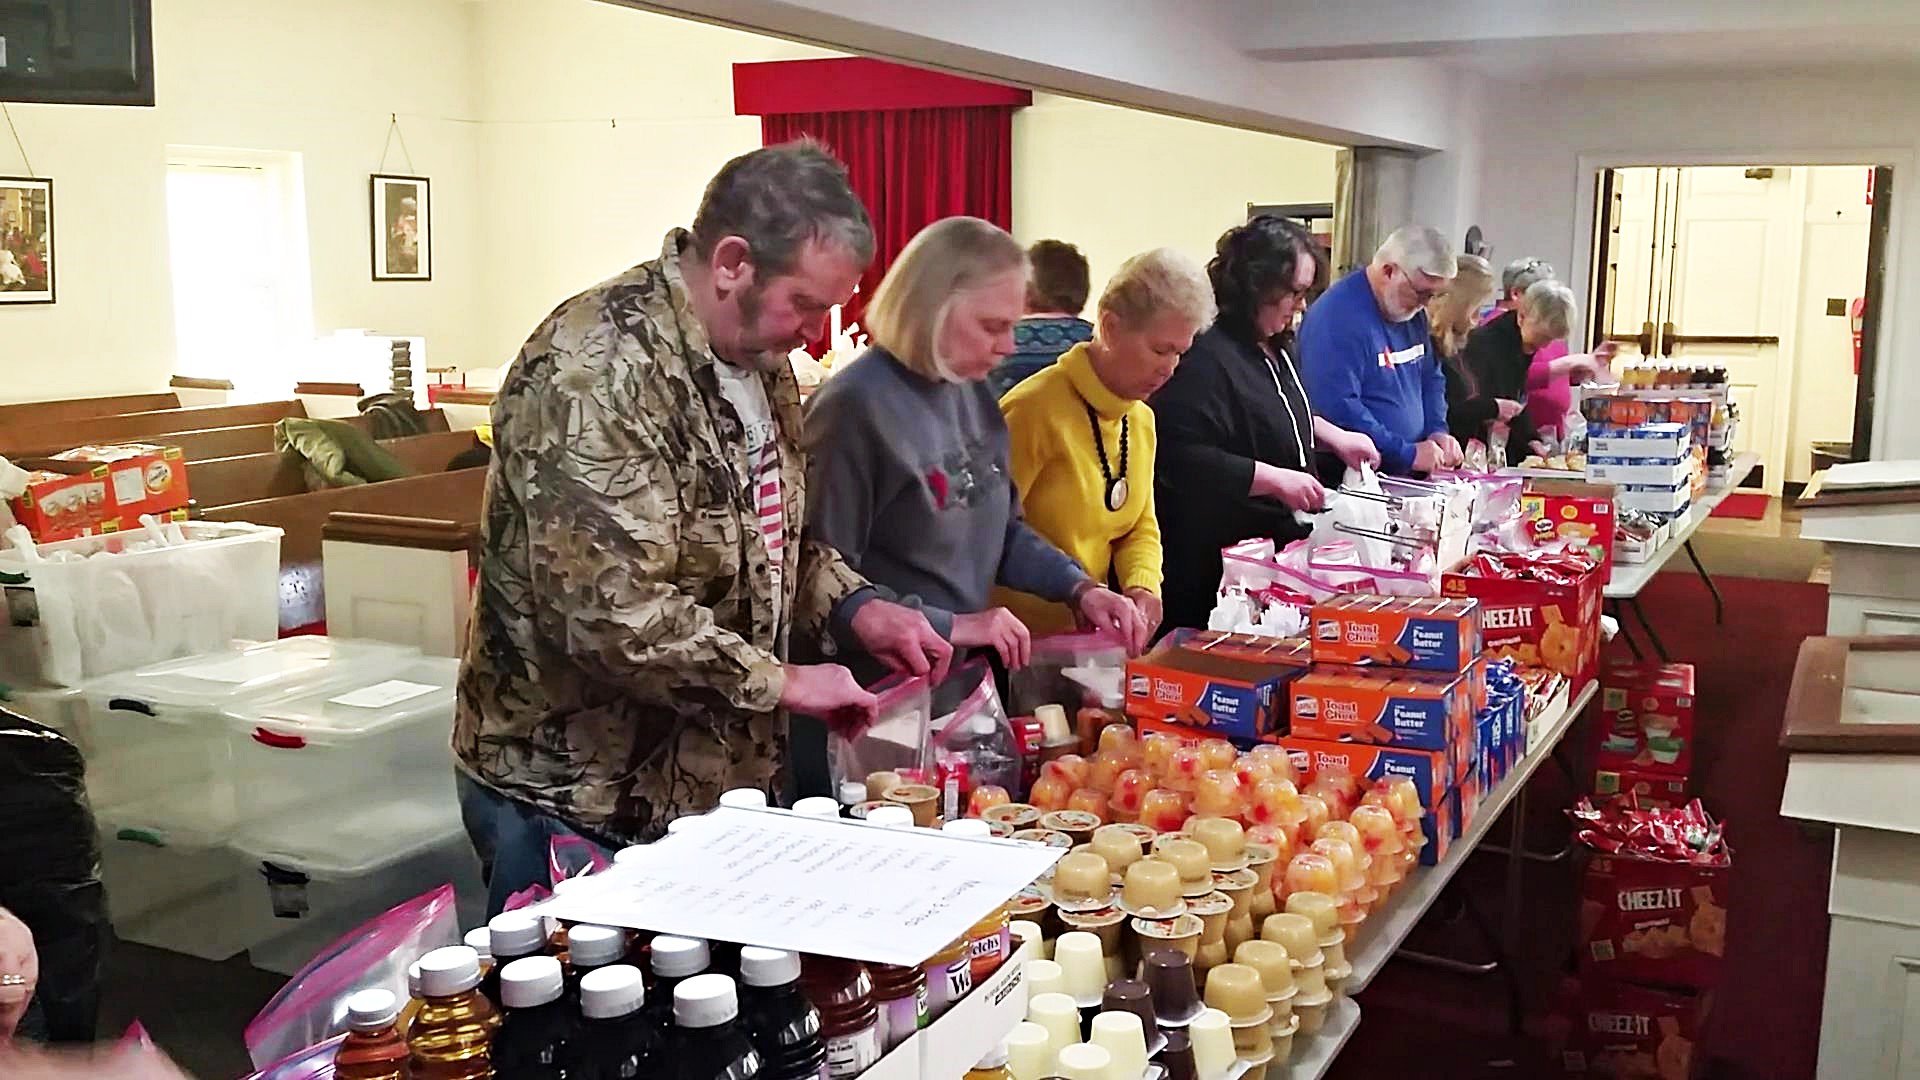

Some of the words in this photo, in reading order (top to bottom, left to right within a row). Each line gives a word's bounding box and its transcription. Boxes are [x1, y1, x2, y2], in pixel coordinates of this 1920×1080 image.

[1482, 606, 1533, 629] HEEZ-IT
[1413, 629, 1443, 640] Peanut
[1413, 638, 1441, 648] Butter
[1394, 707, 1427, 720] Peanut
[1394, 717, 1425, 728] Butter
[971, 938, 999, 956] elch's
